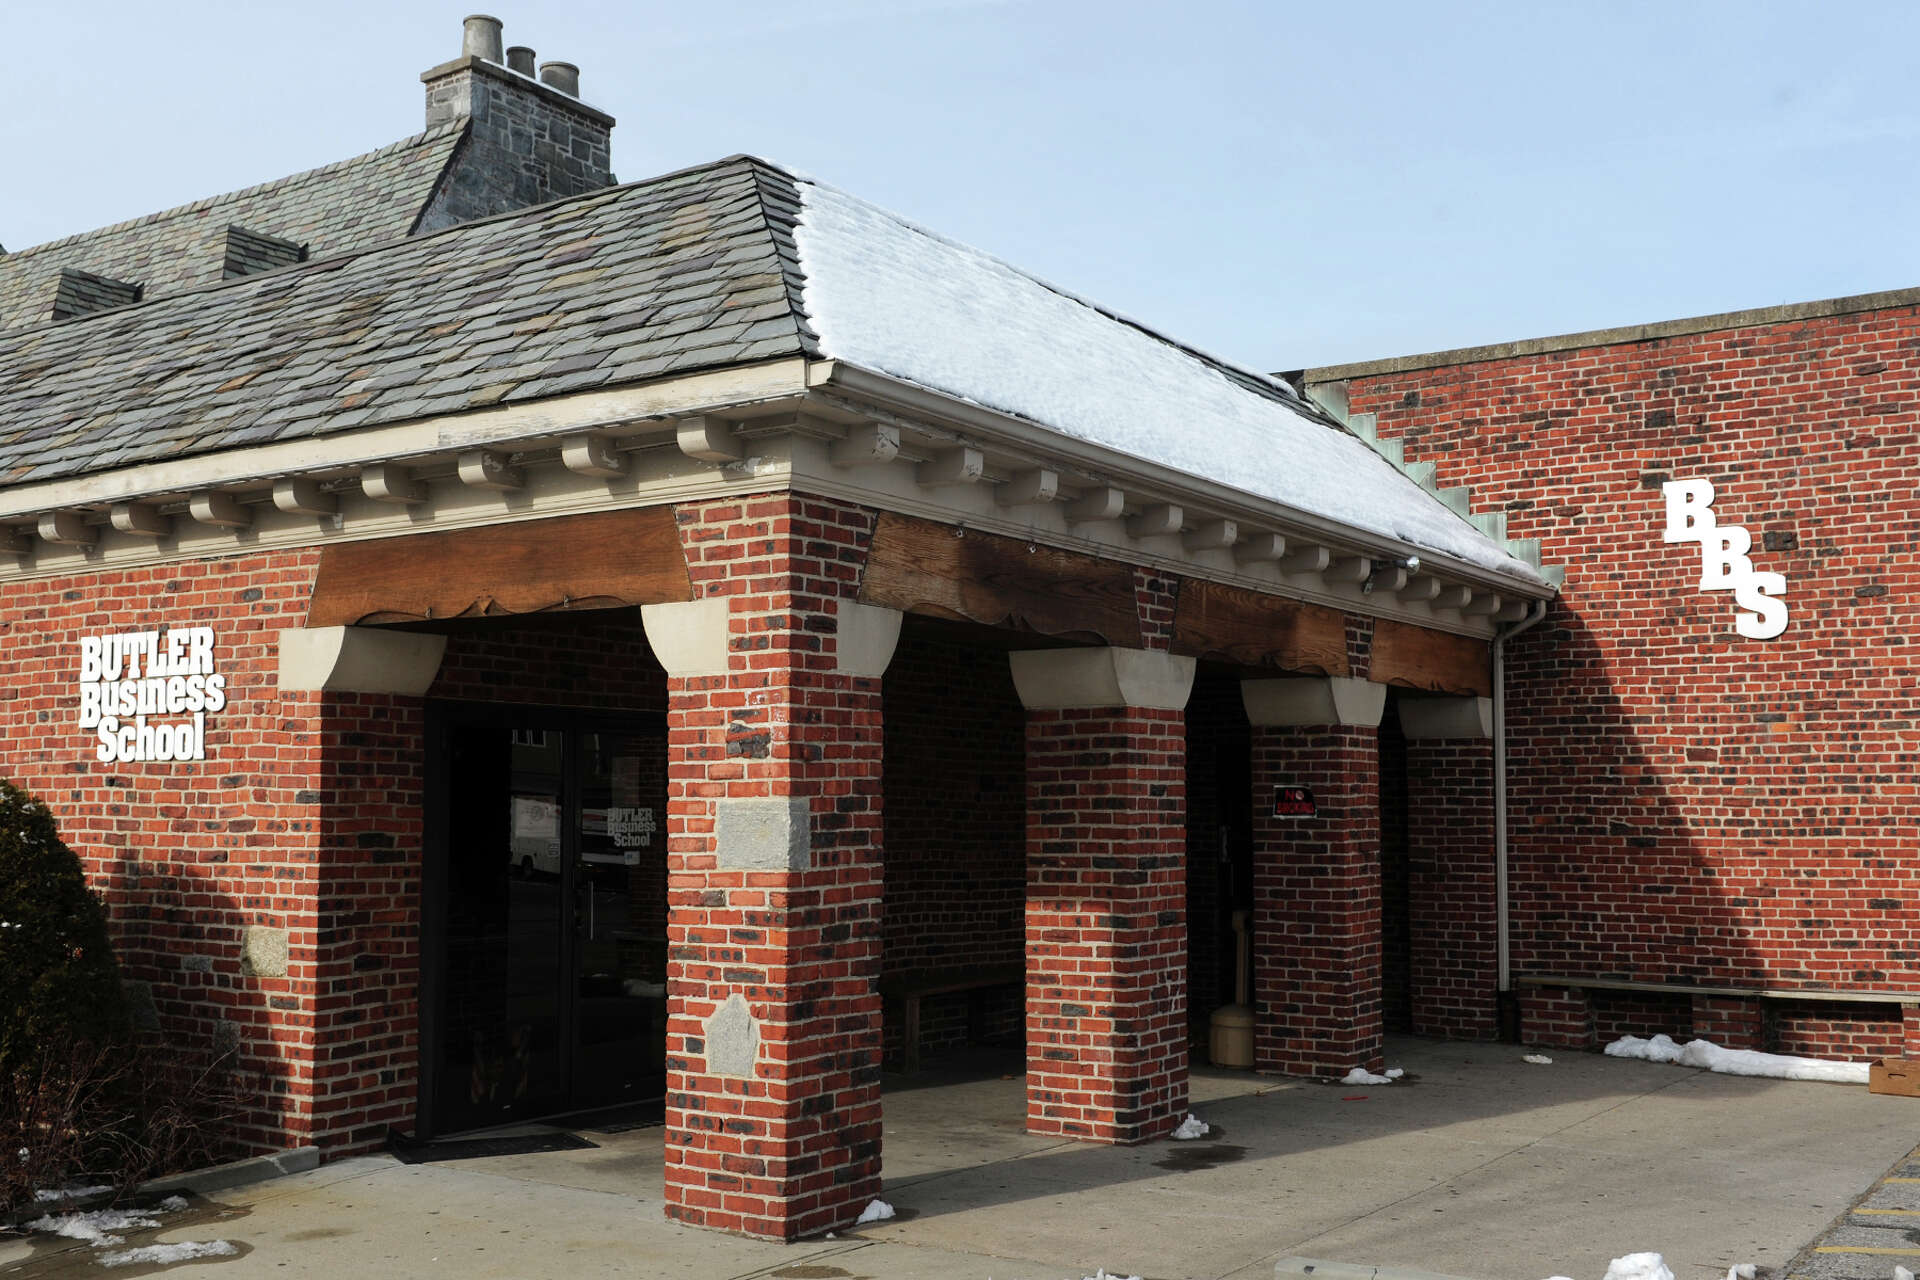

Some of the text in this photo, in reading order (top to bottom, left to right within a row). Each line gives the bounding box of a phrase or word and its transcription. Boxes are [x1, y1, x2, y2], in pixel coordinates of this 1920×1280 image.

[1663, 479, 1788, 639] BBS
[80, 627, 214, 682] BUTLER
[79, 674, 226, 728] Business
[97, 712, 205, 762] School
[1285, 789, 1304, 800] NO
[607, 808, 652, 821] BUTLER
[607, 820, 656, 836] Business
[613, 832, 650, 846] School
